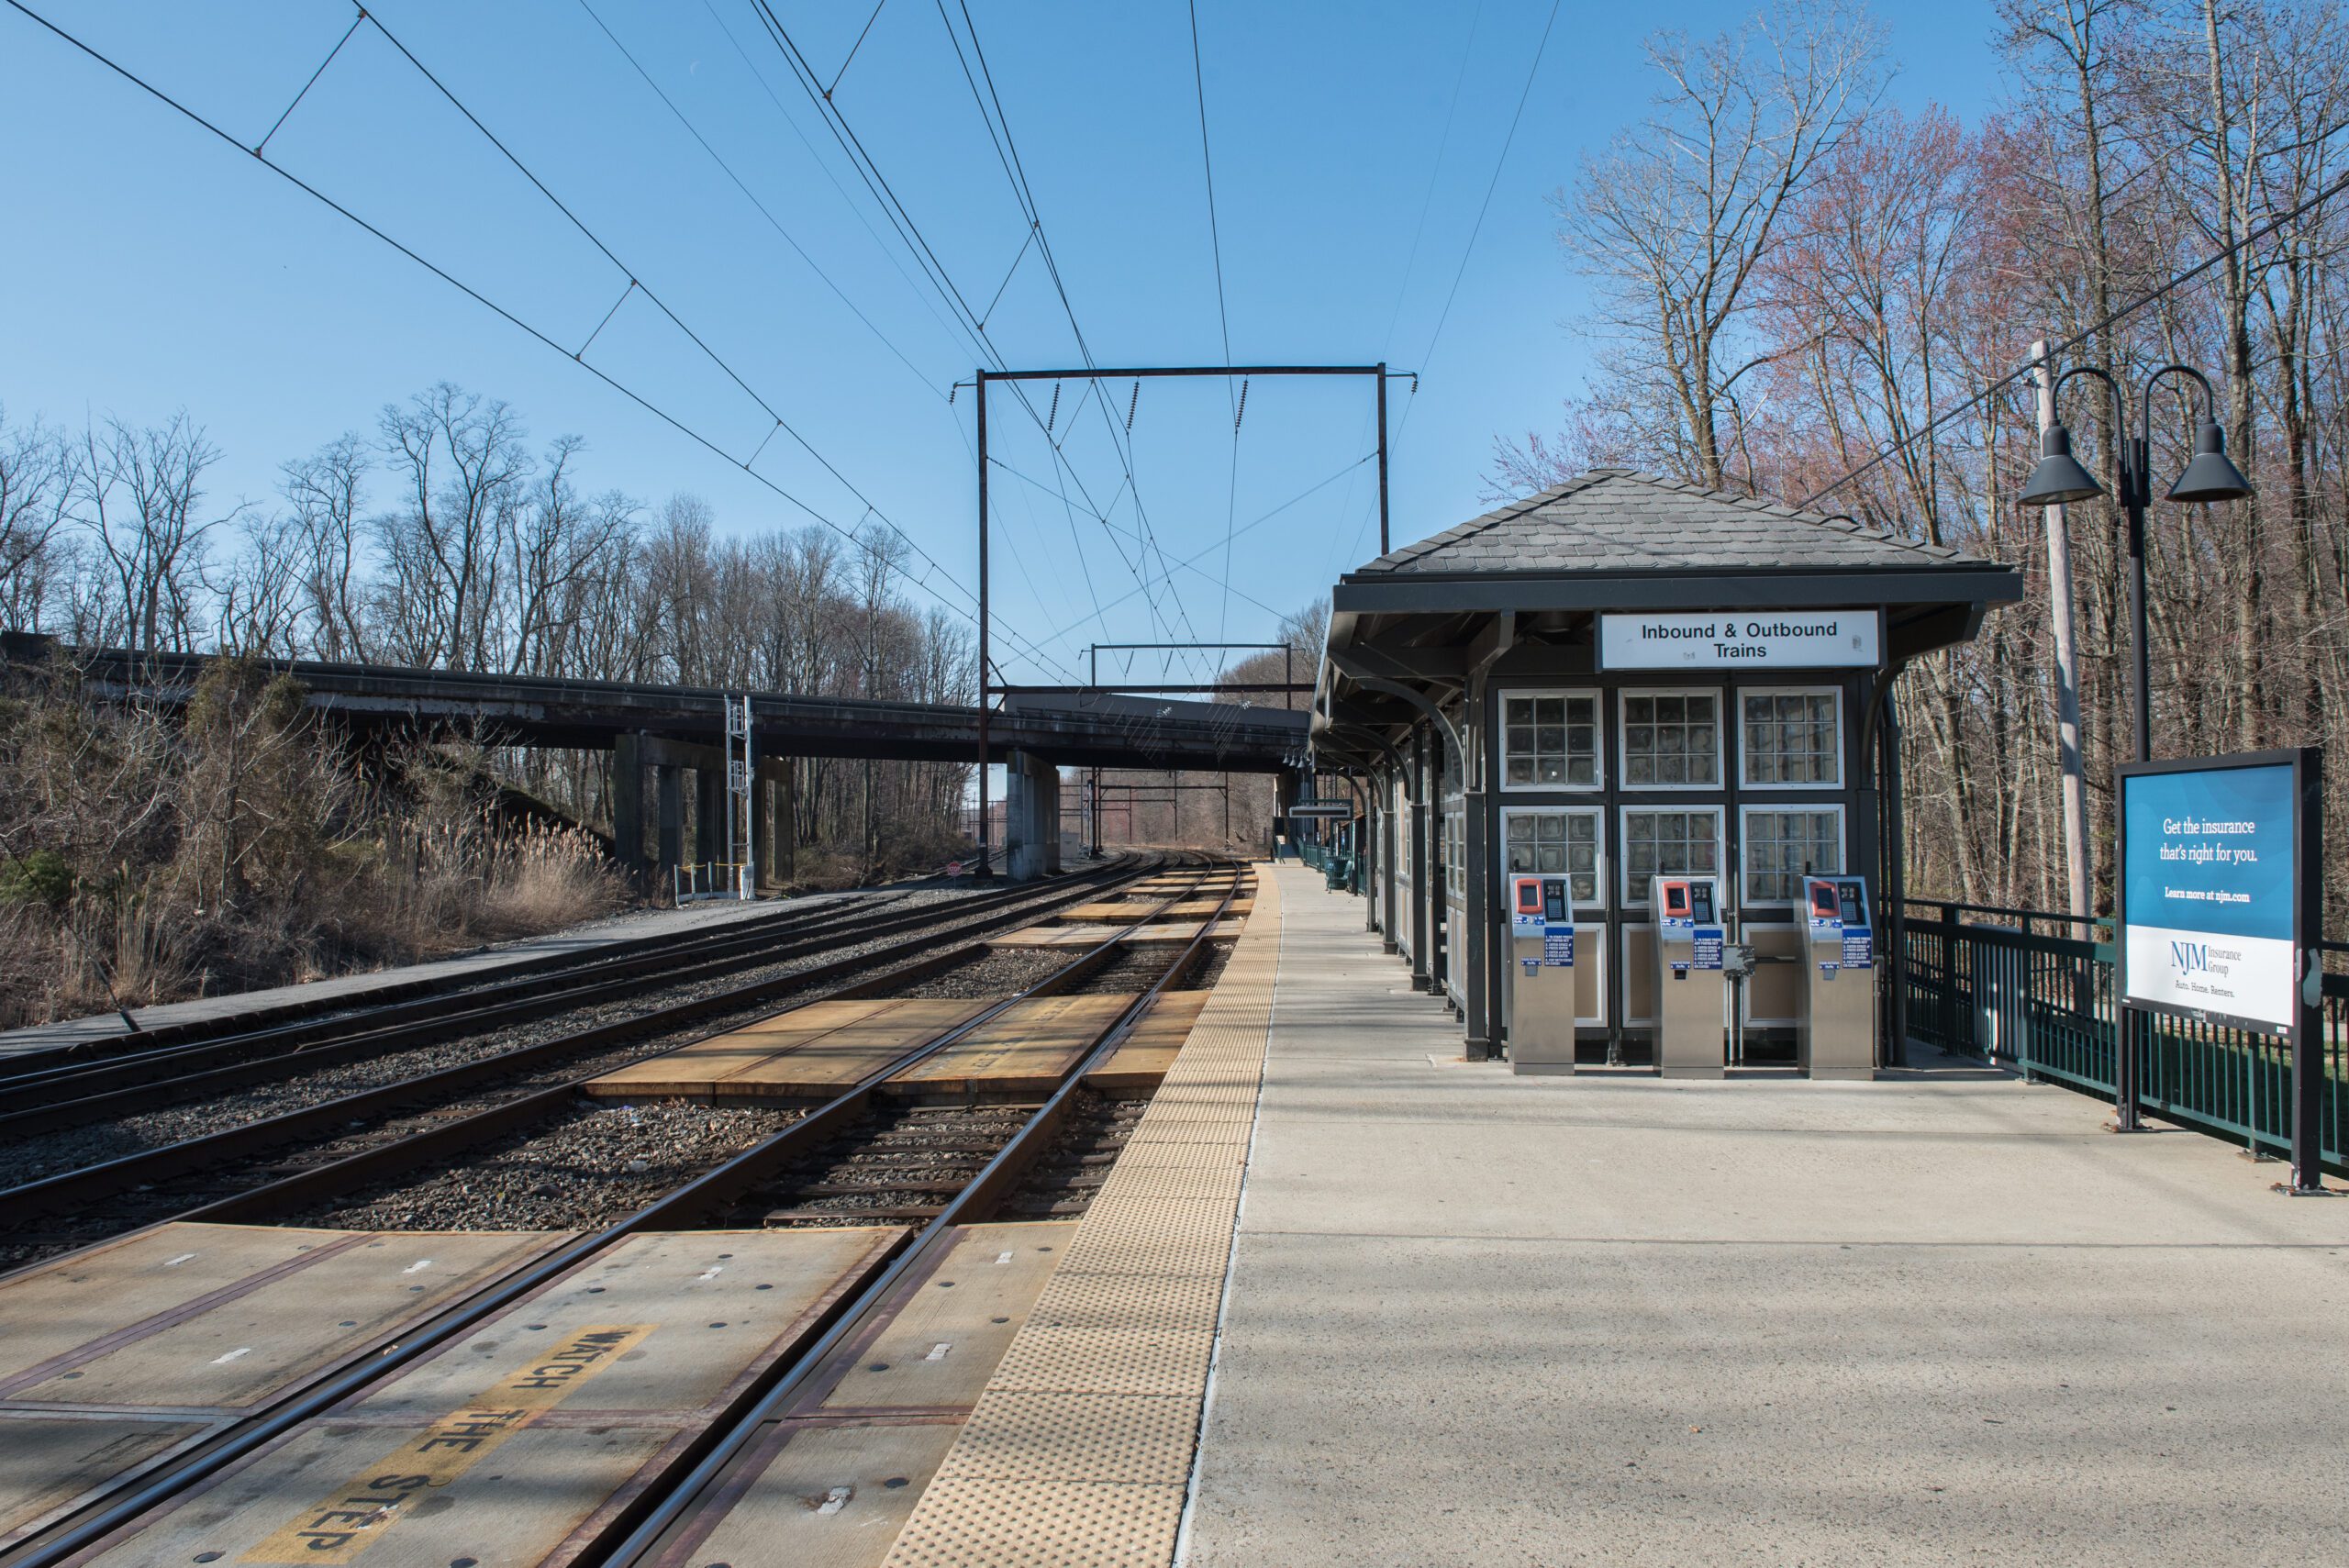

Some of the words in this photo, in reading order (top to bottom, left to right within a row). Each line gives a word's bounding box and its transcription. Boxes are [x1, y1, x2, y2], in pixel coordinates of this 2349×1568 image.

[1642, 623, 1715, 639] Inbound
[1724, 623, 1737, 638] &
[1746, 621, 1837, 638] Outbound
[1714, 643, 1766, 658] Trains
[2163, 818, 2181, 834] Get
[2183, 817, 2199, 834] the
[2202, 817, 2255, 834] insurance
[2160, 842, 2186, 860] that's
[2188, 842, 2213, 864] right
[2216, 842, 2232, 861] for
[2233, 850, 2257, 865] you.
[2165, 886, 2185, 898] Learn
[2186, 890, 2205, 899] more
[2206, 890, 2214, 900] at
[2215, 890, 2250, 904] njm.com
[2171, 940, 2208, 975] NJM
[2208, 946, 2242, 961] Insurance
[2208, 961, 2229, 978] Group
[2176, 979, 2190, 990] Auto.
[2210, 984, 2235, 997] Renters.
[512, 1329, 632, 1389] WATCH
[417, 1408, 526, 1453] THE
[296, 1473, 430, 1551] STEP
